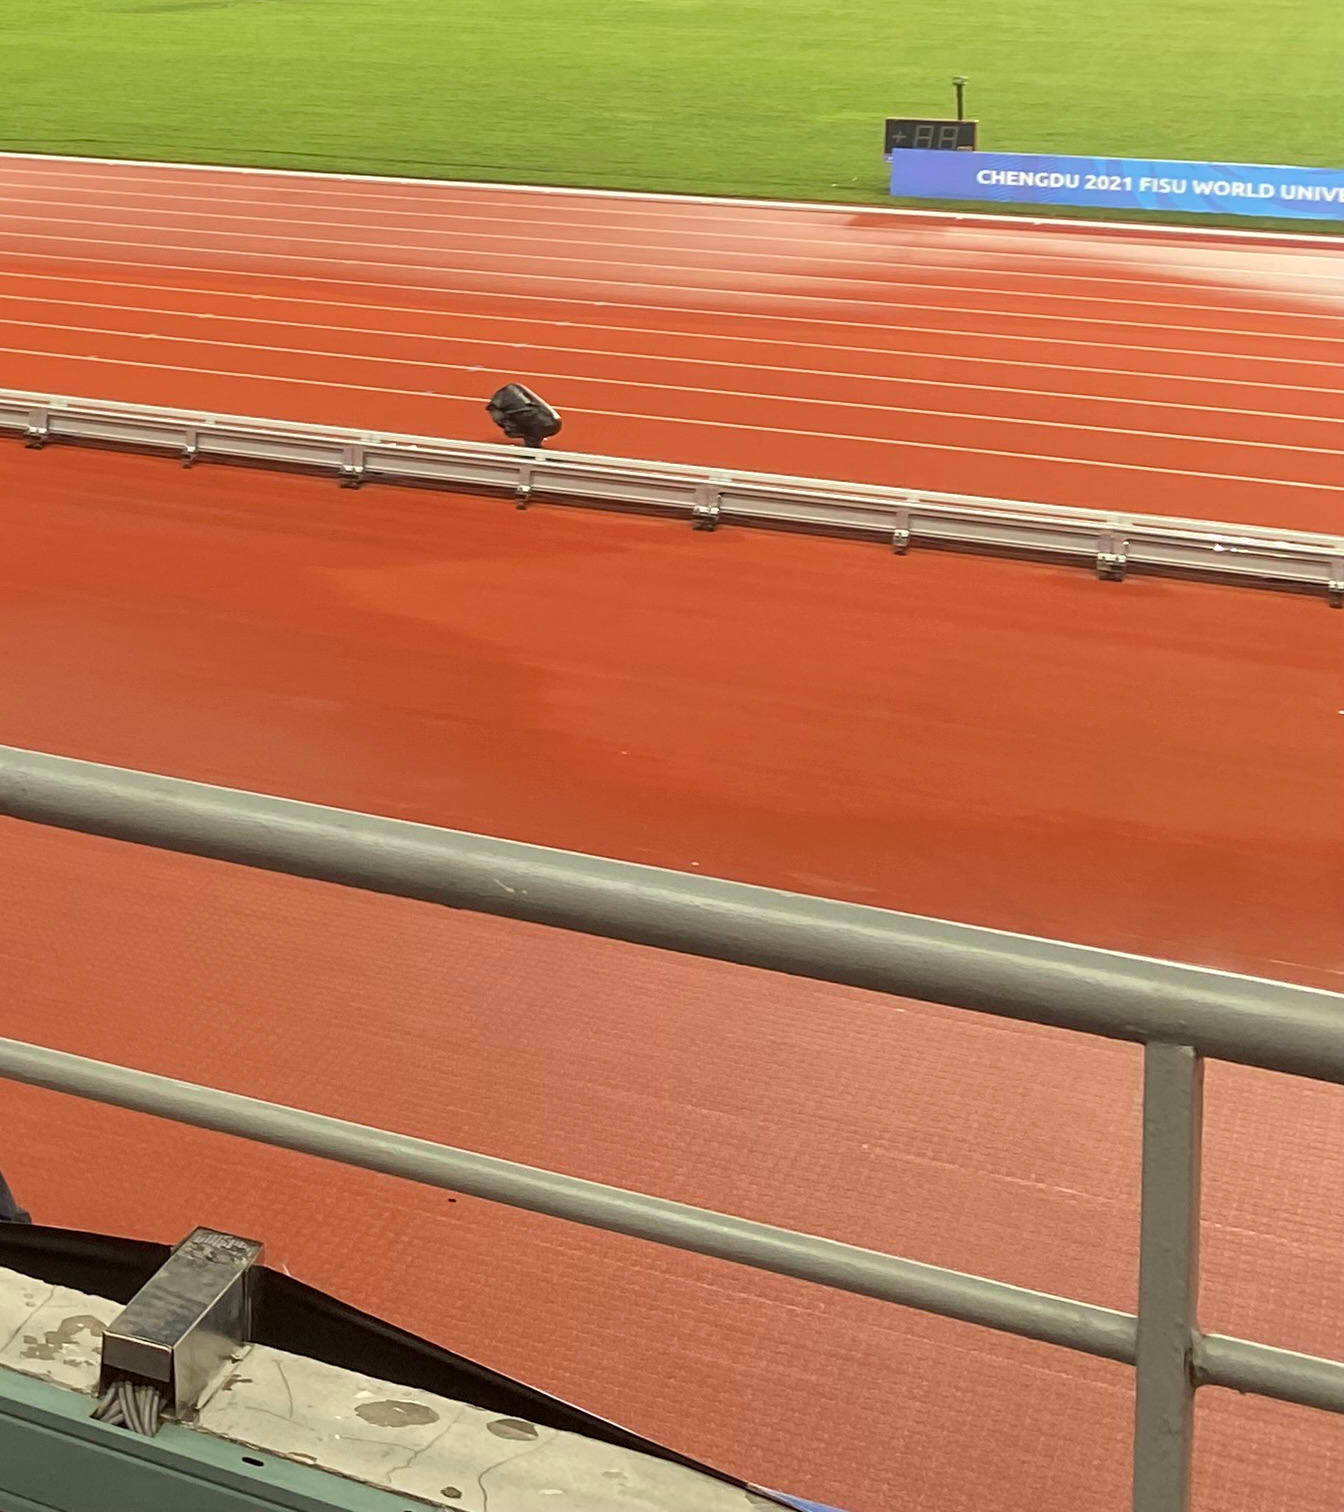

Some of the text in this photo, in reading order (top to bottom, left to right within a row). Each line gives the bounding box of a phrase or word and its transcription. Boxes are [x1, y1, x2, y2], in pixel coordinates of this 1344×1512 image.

[976, 168, 1080, 189] CHENGDU
[1084, 174, 1133, 193] 2021
[1139, 177, 1188, 195] FISU
[1191, 180, 1275, 200] WORLD
